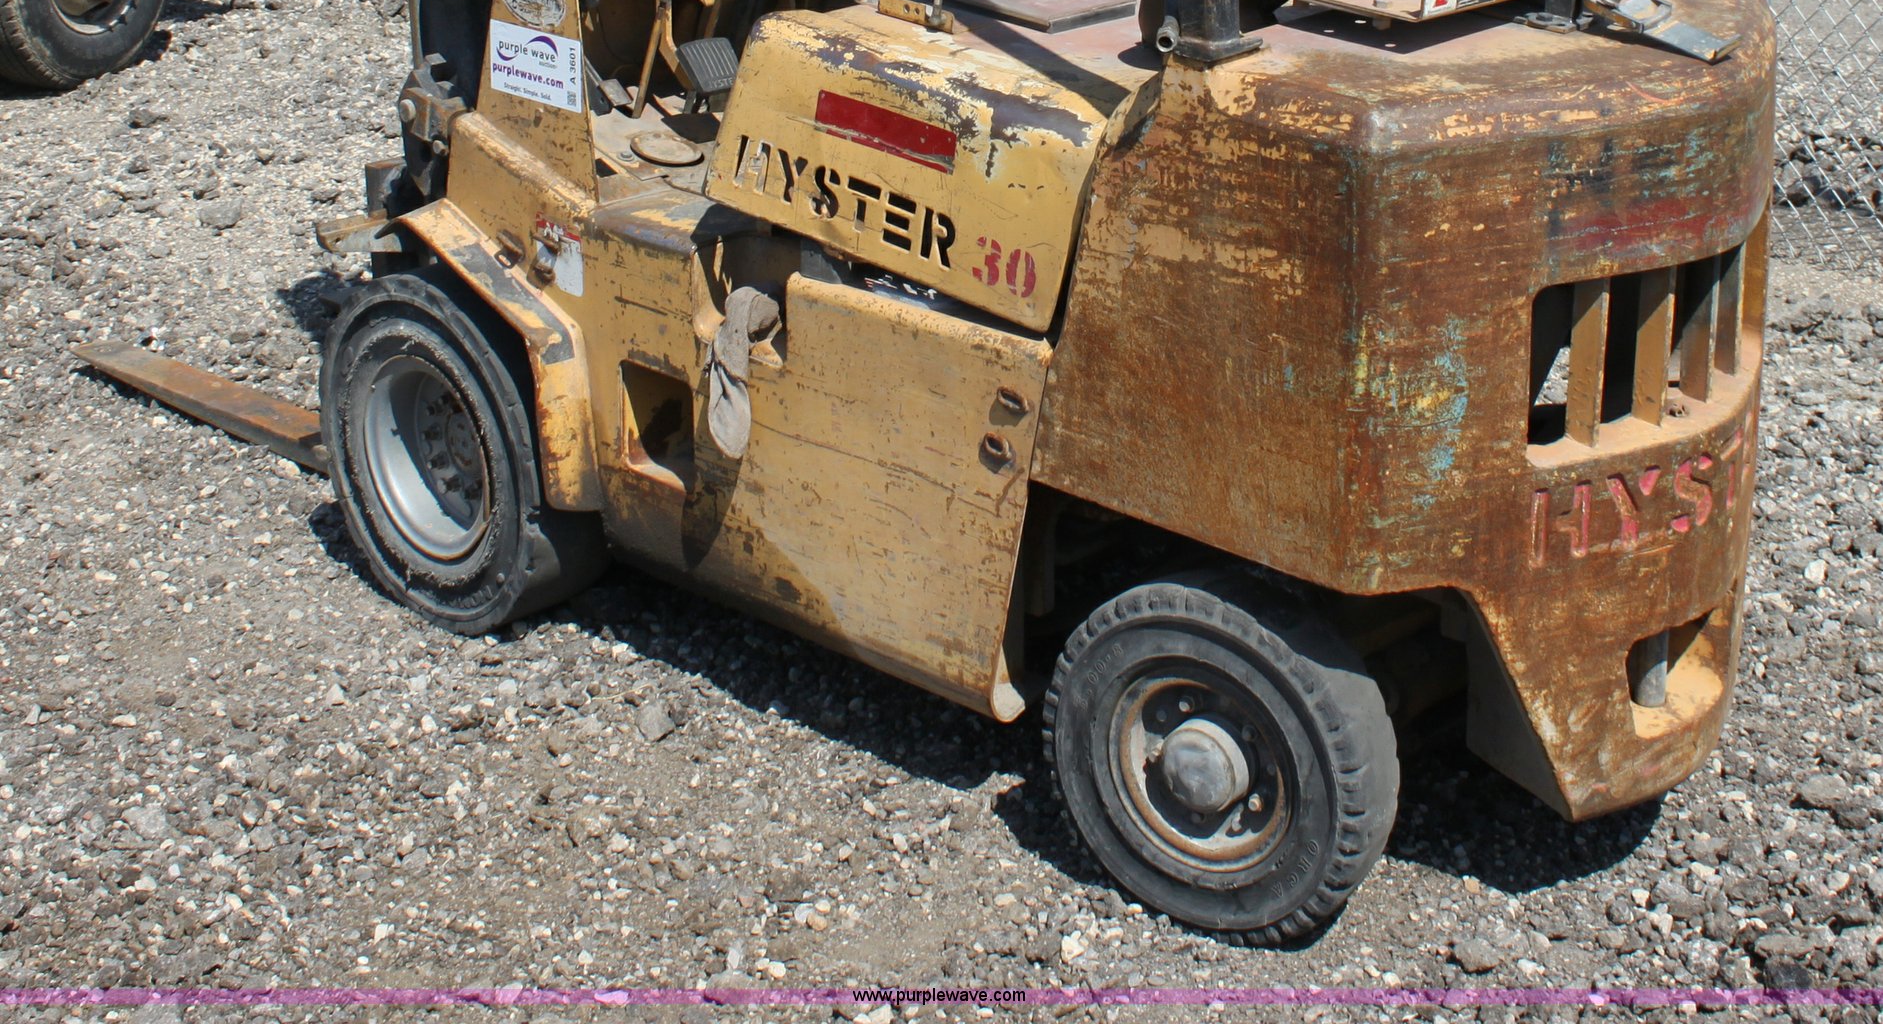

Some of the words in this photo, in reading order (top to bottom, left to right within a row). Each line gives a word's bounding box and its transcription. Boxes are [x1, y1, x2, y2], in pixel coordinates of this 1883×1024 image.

[498, 40, 528, 56] purple
[531, 48, 556, 63] wave
[569, 47, 577, 74] 3601
[492, 62, 564, 90] purplewave.com
[569, 77, 577, 85] A
[733, 134, 956, 271] HYSTER
[972, 235, 1037, 298] 30
